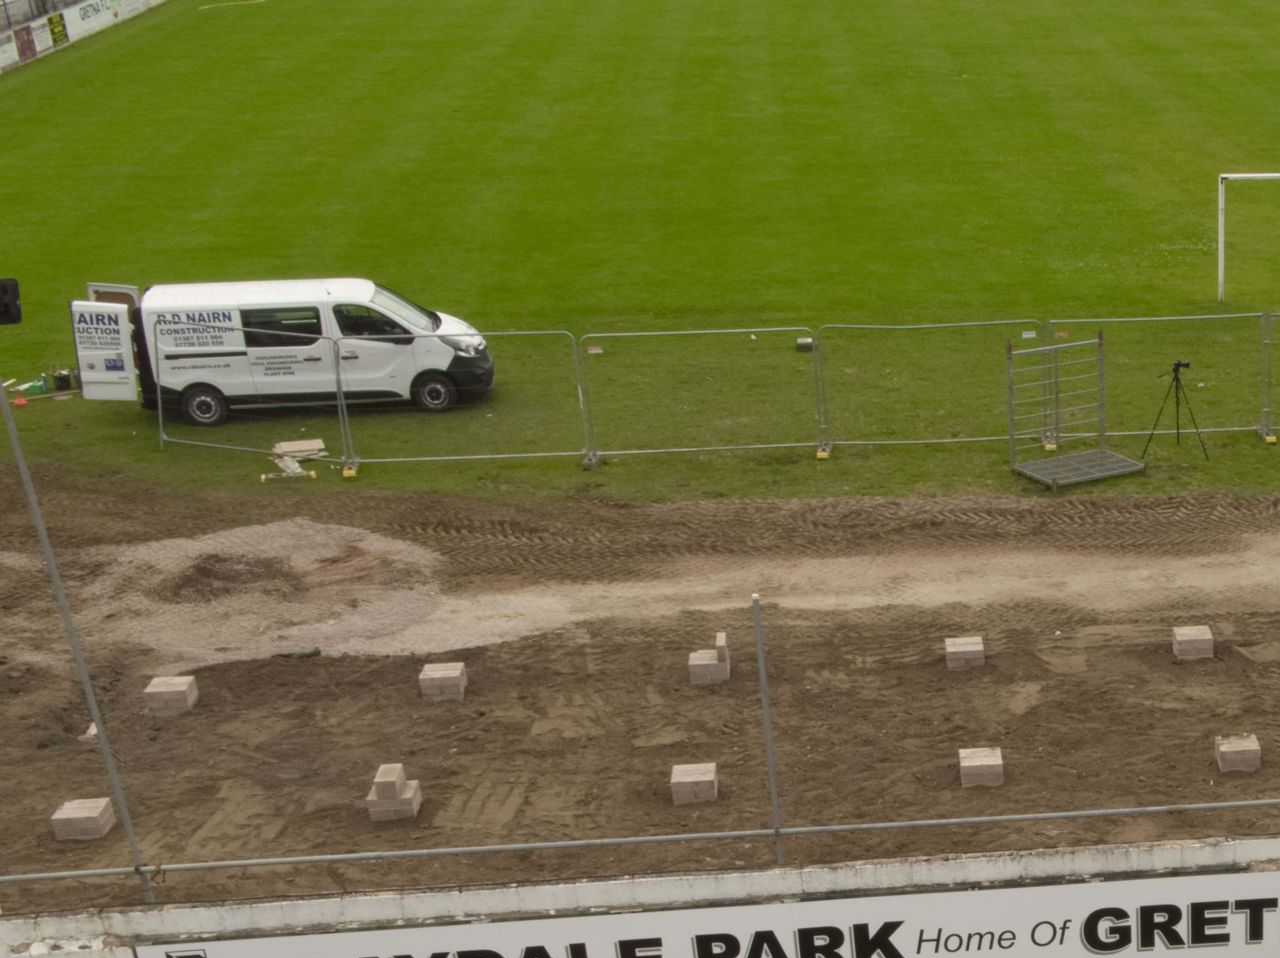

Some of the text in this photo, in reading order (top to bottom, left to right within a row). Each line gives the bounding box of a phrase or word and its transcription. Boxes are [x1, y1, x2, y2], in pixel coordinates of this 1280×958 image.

[186, 311, 232, 323] NAIRN
[159, 326, 234, 336] CONSTRUCTION
[916, 925, 1017, 955] Home
[1030, 919, 1073, 947] Of
